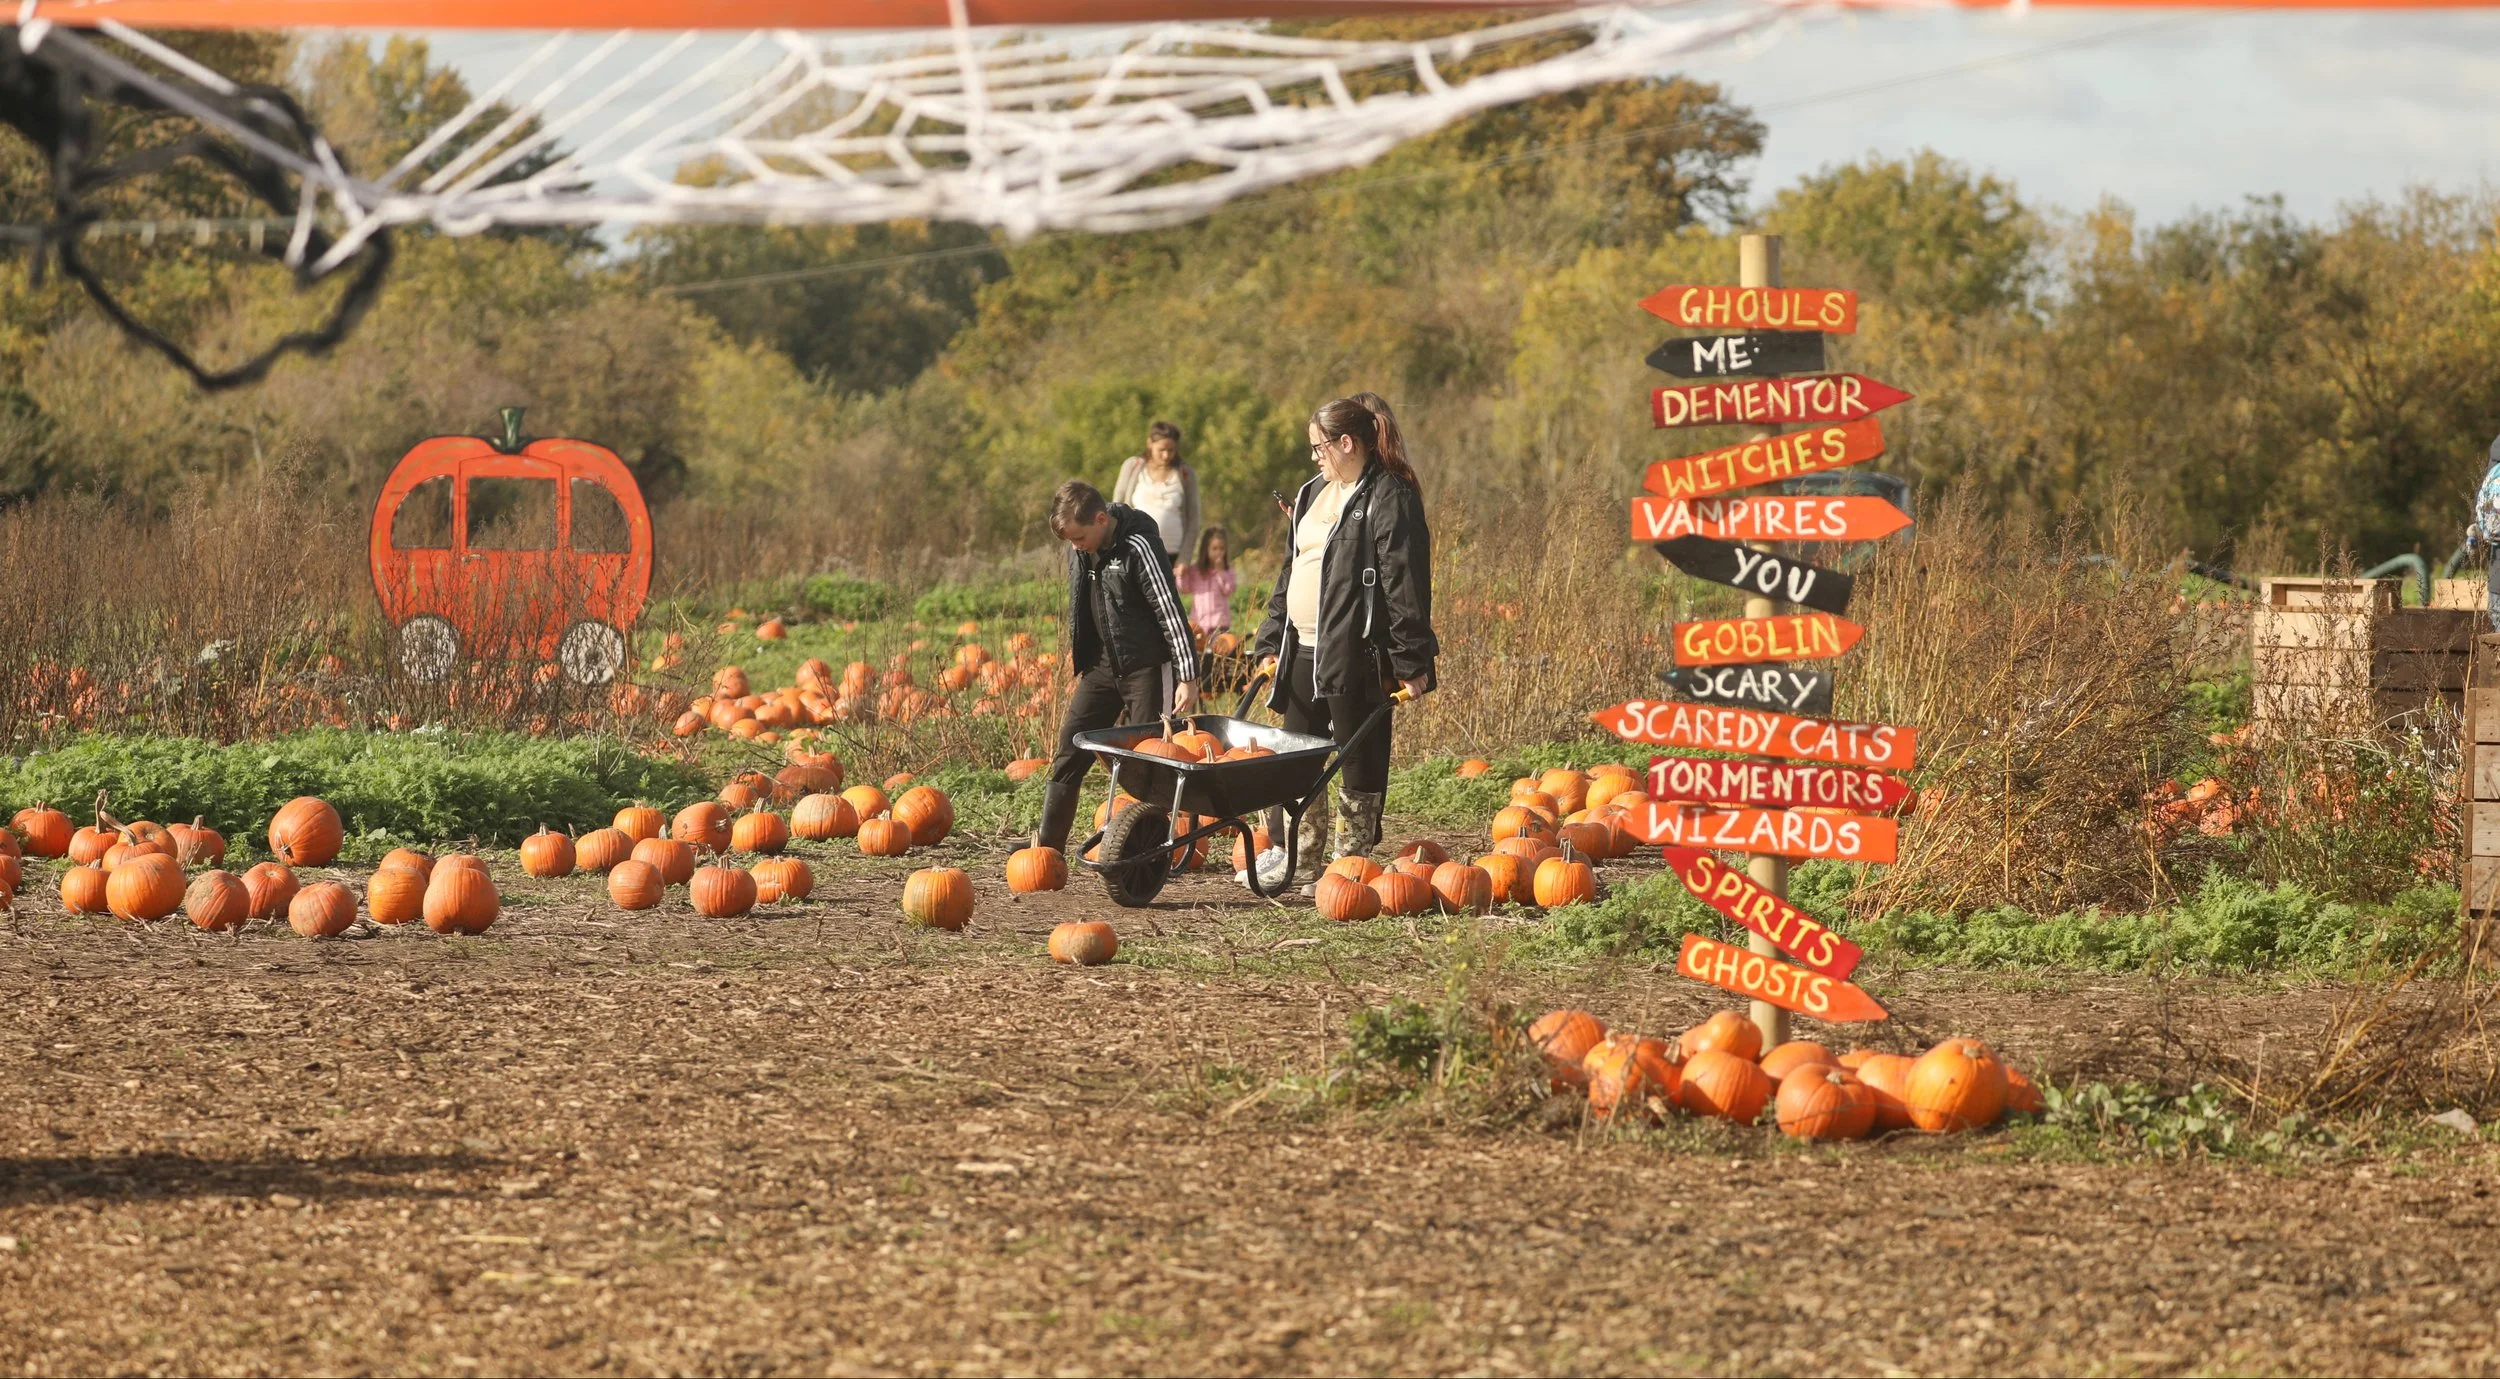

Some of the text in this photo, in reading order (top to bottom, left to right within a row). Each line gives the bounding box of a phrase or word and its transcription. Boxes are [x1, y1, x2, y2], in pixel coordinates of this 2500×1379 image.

[1679, 288, 1846, 326] GHOULS
[1662, 376, 1869, 425] DEMENTOR
[1662, 429, 1846, 498] WITCHES
[1642, 500, 1847, 537] VAMPIRES
[1731, 547, 1816, 602] YOU
[1683, 617, 1841, 661] GOBLIN
[1689, 668, 1817, 707] SCARY
[1617, 701, 1895, 762] SCAREDY CATS
[1650, 758, 1884, 806] TORMENTORS
[1648, 802, 1861, 855] WIZARDS
[1687, 857, 1839, 966] SPIRITS
[1687, 943, 1831, 1012] GHOSTS
